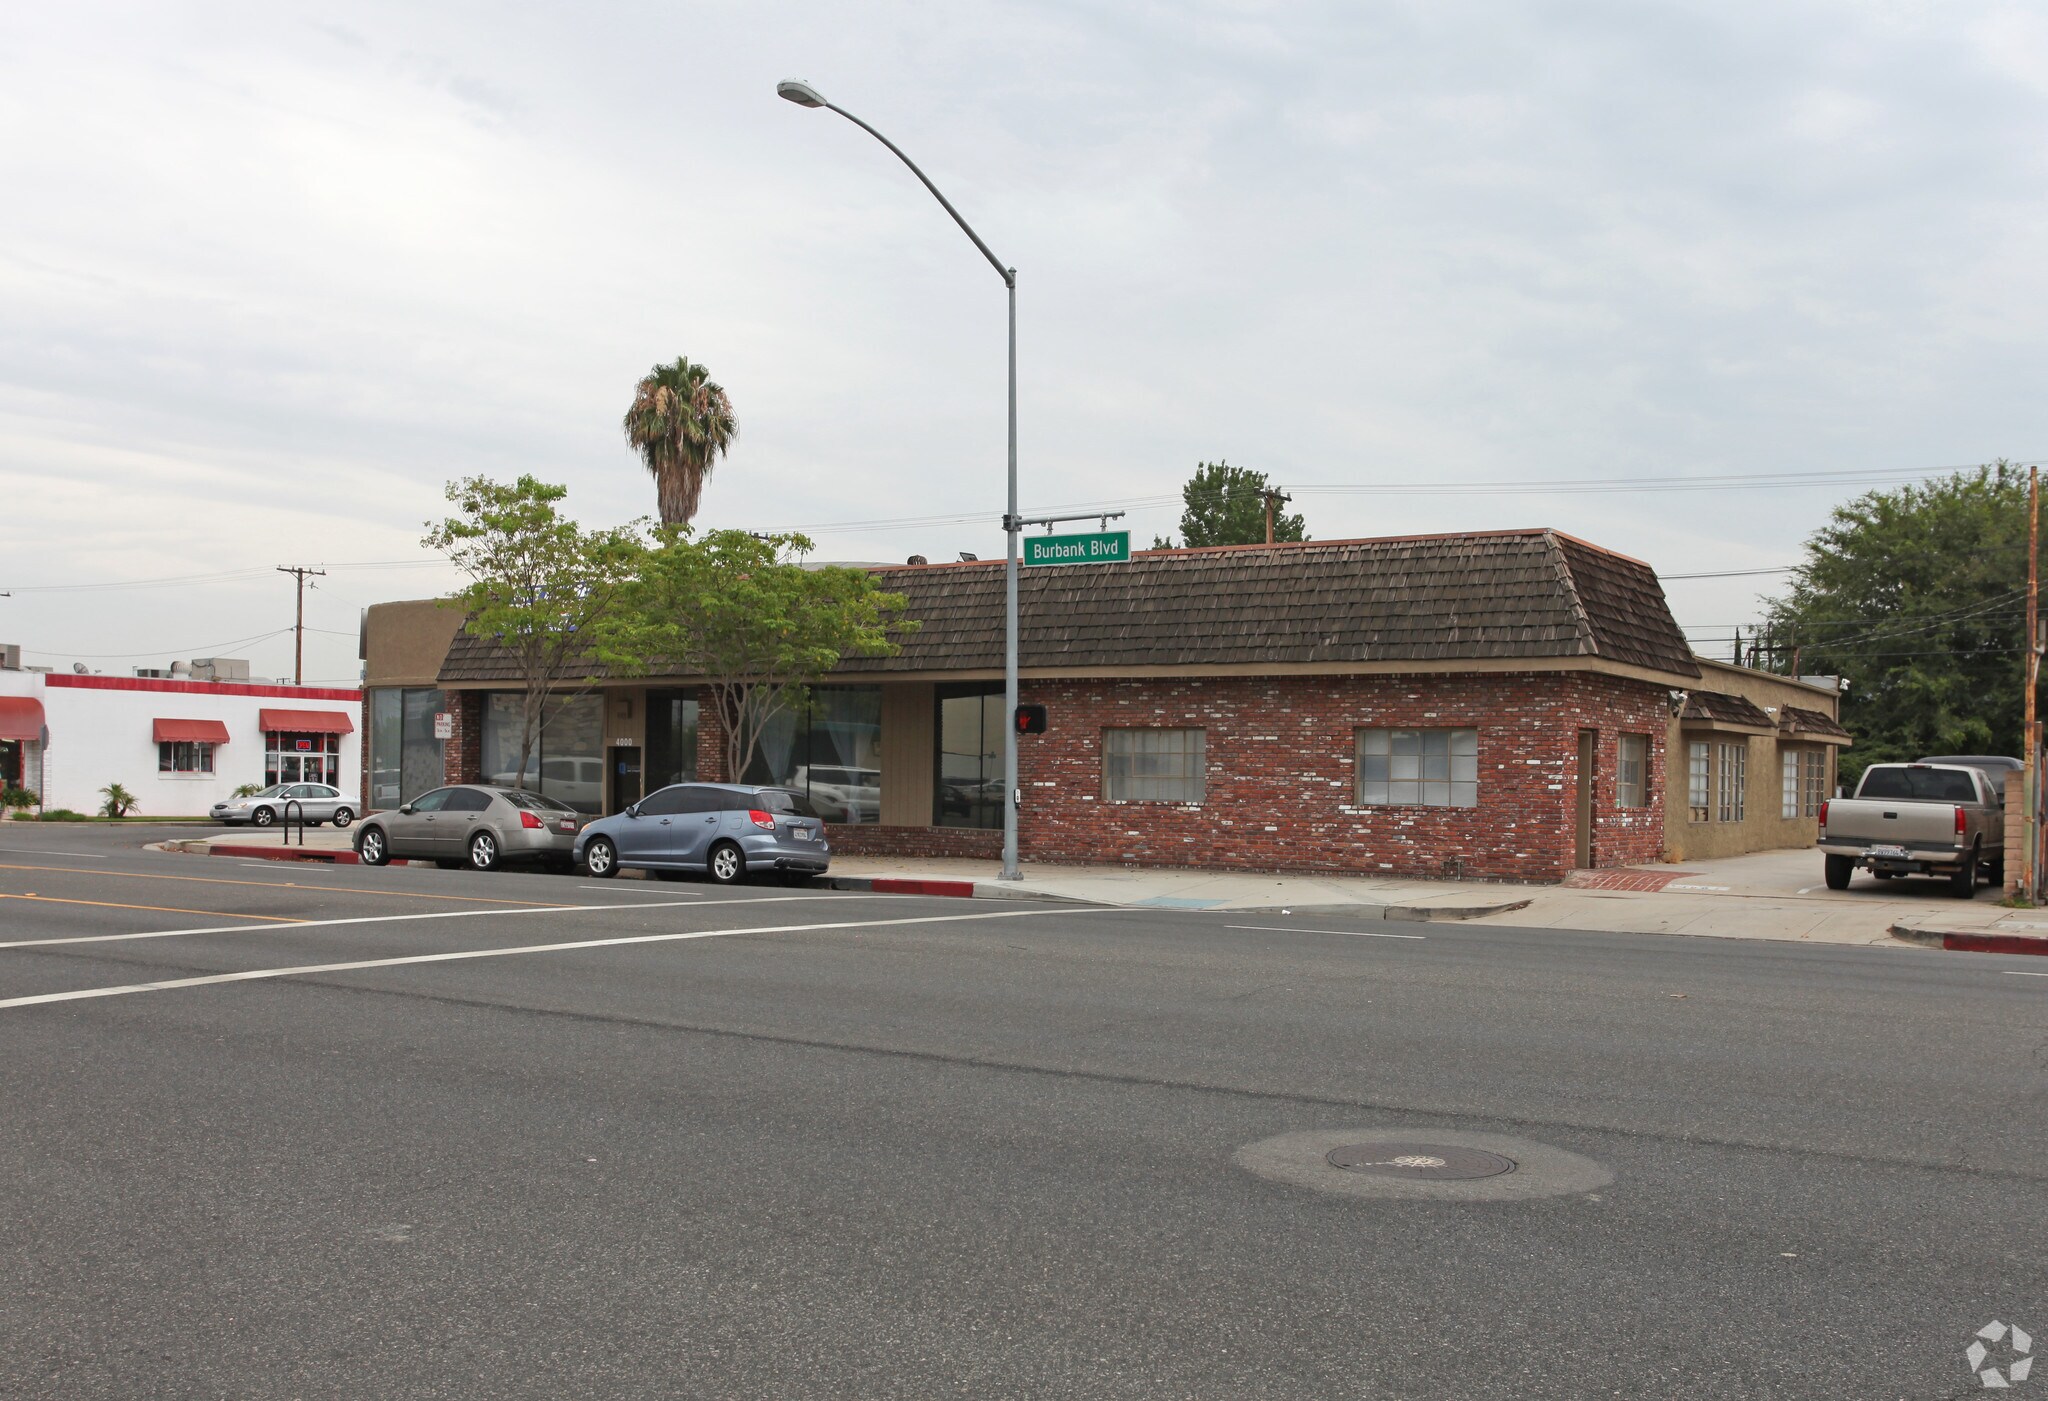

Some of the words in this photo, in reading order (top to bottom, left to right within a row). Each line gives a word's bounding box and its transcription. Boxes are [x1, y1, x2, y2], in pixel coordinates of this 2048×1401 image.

[1034, 542, 1086, 558] Burbank
[1091, 540, 1118, 555] Blvd
[616, 738, 633, 746] 4000
